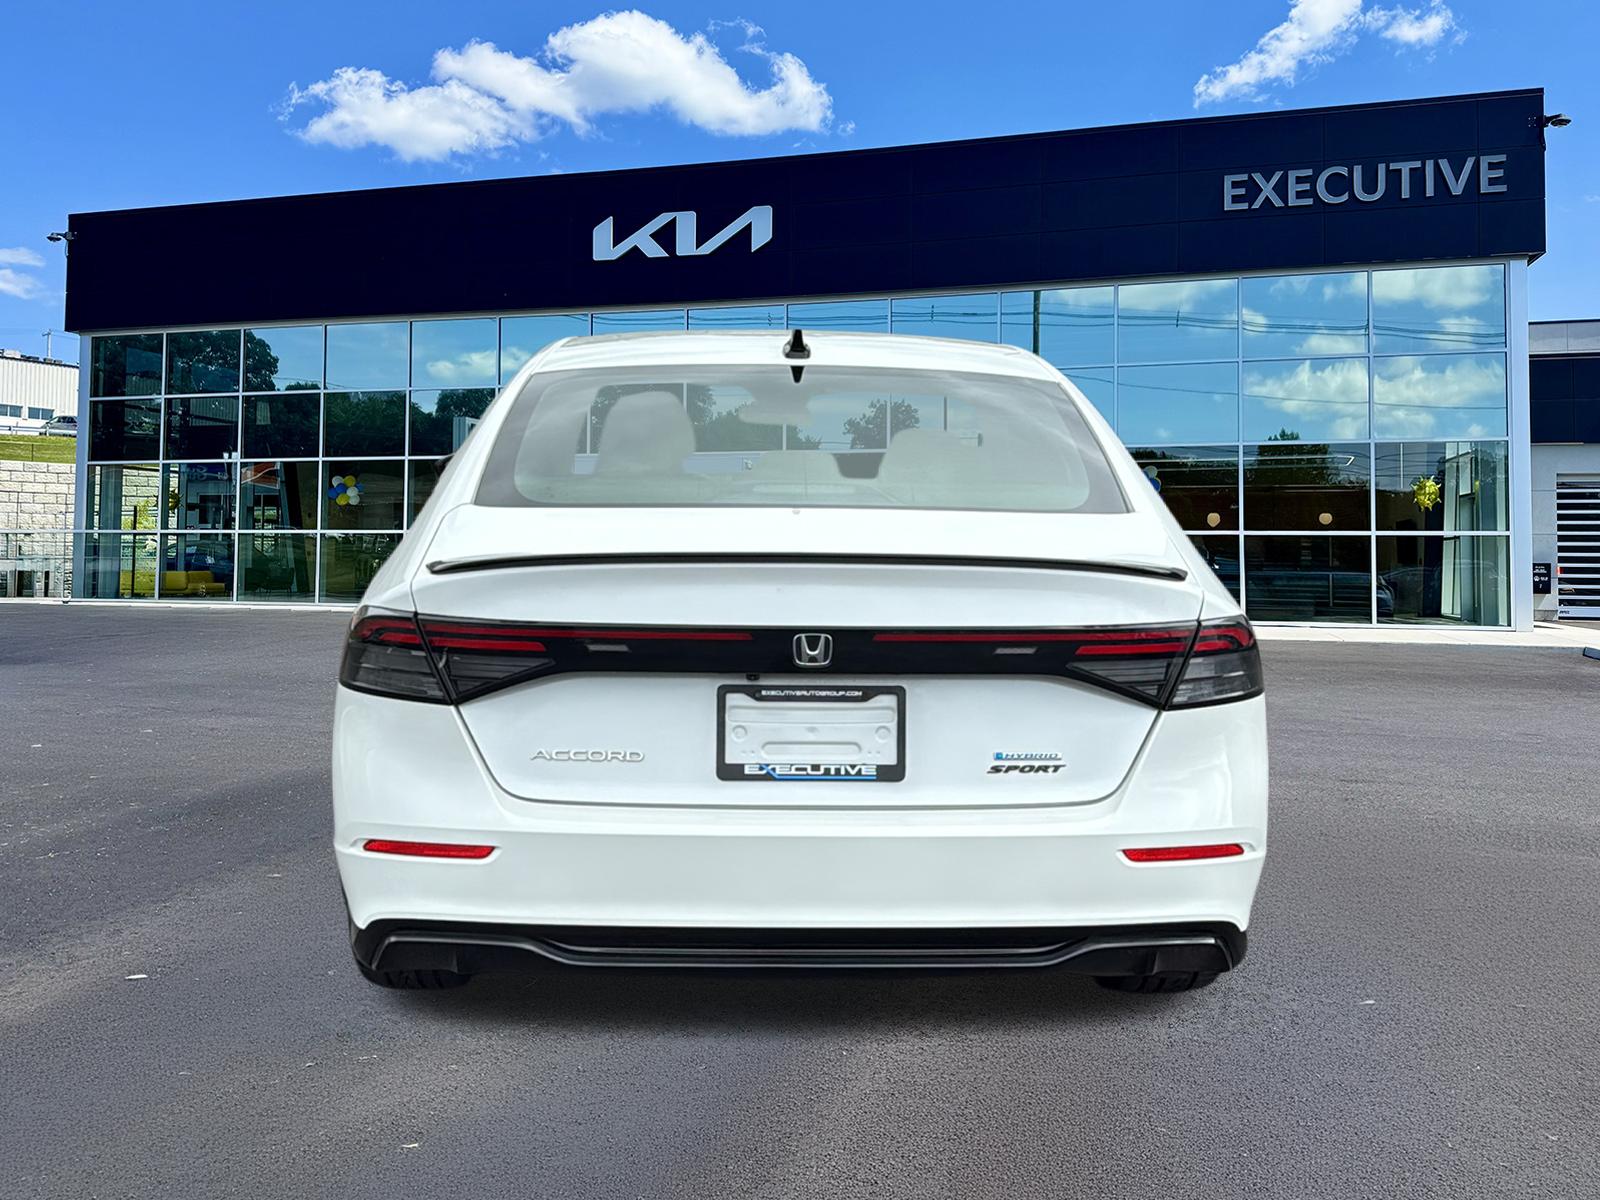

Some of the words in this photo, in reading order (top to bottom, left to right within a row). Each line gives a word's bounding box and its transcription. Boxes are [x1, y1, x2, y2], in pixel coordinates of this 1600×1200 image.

[1223, 154, 1508, 212] EXECUTIVE
[530, 748, 645, 763] ACCORD
[743, 764, 877, 776] EXECUTIVE
[986, 764, 1067, 774] SPORT
